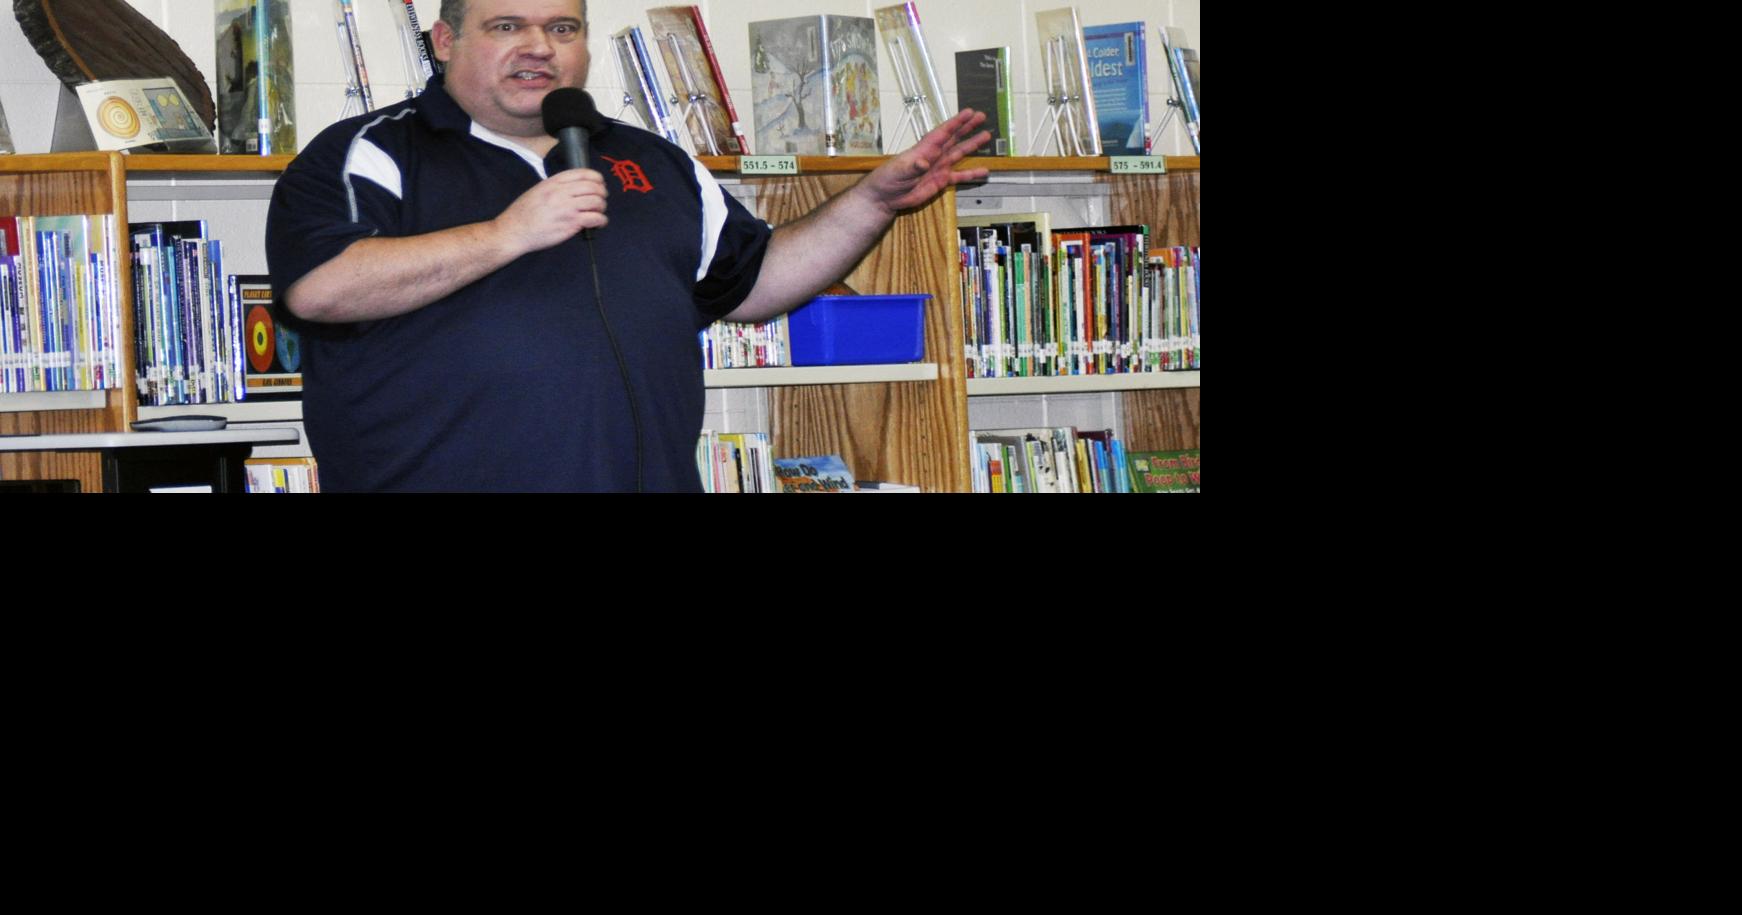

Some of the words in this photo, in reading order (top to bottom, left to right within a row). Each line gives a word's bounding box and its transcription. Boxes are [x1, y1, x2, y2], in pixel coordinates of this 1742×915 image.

[1090, 60, 1123, 78] ldest
[743, 160, 769, 170] 551.5
[778, 160, 795, 170] 574
[1113, 161, 1129, 170] 575
